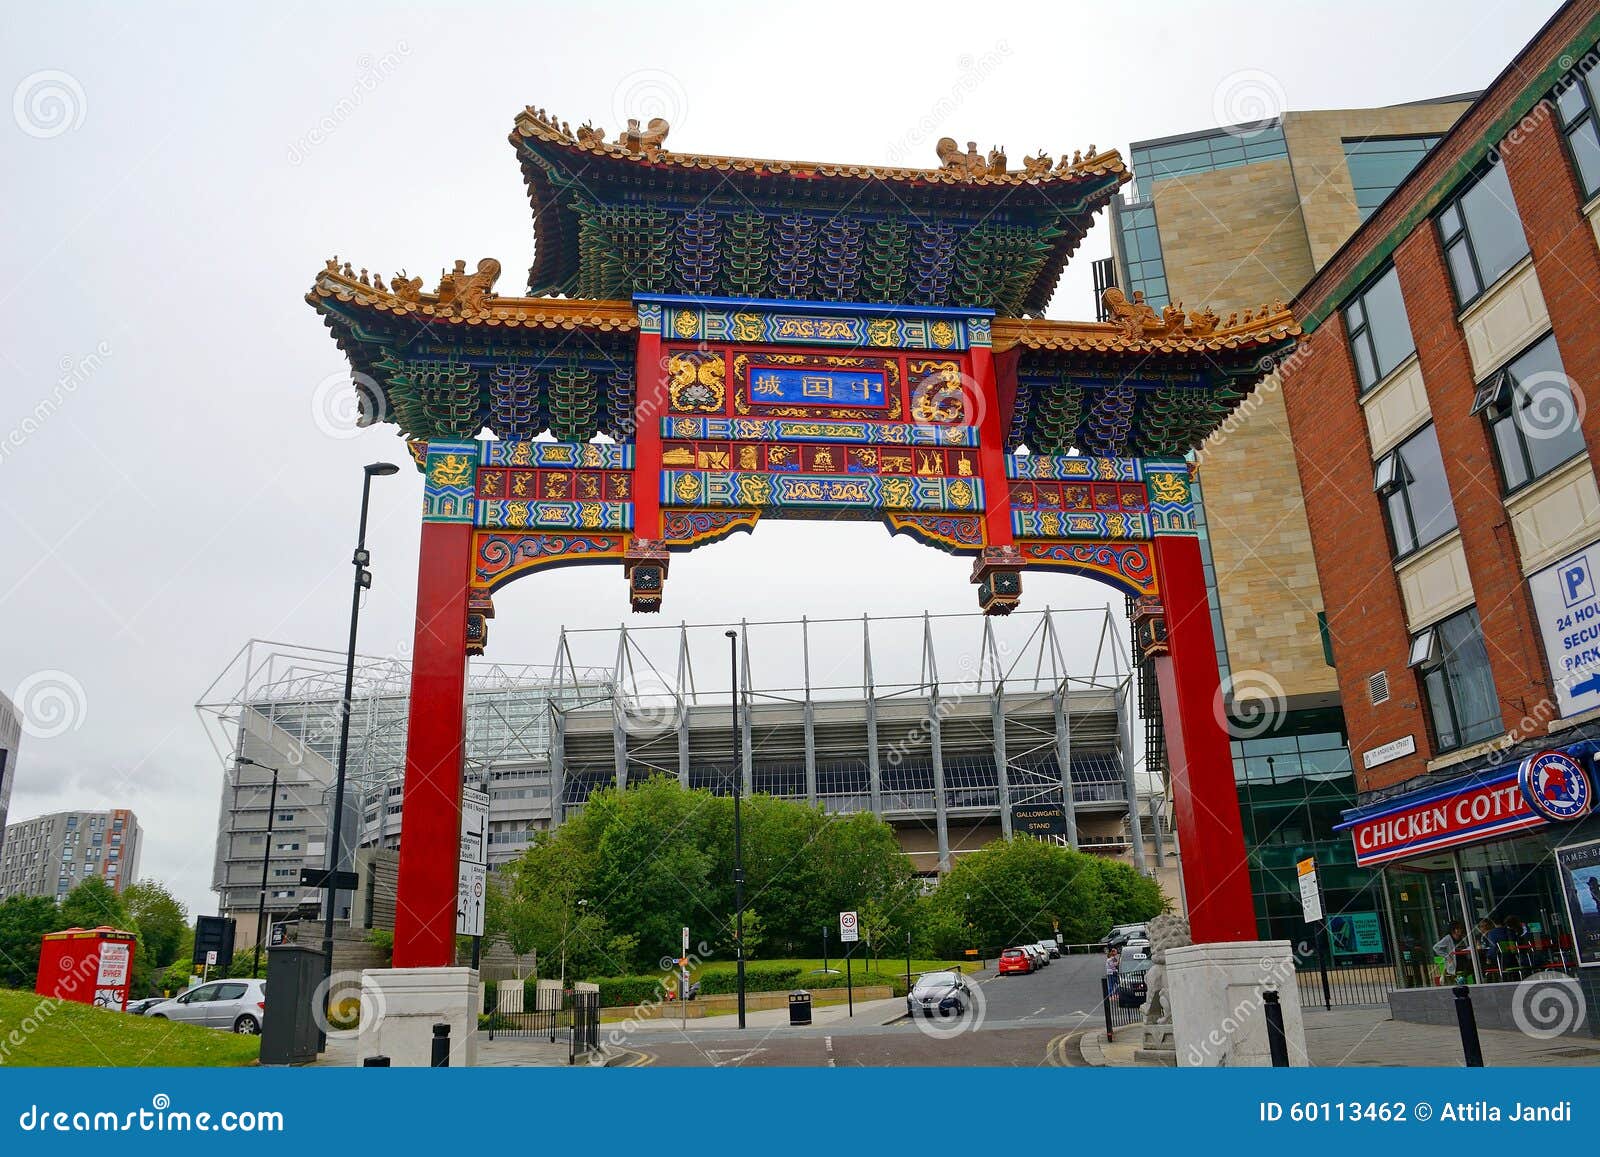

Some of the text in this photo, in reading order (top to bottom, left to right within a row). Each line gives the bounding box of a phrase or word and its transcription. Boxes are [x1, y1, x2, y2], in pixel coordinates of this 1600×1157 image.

[1565, 566, 1585, 600] P
[1556, 614, 1573, 632] 24
[1563, 622, 1600, 650] SECU
[1565, 645, 1600, 672] PARK
[1534, 756, 1582, 781] CHICKEN
[1016, 810, 1060, 818] GALLOWGATE
[1537, 790, 1584, 815] COTTAGE
[1028, 822, 1050, 830] STAND
[1360, 806, 1447, 849] CHICKEN
[1561, 850, 1588, 864] JAMES
